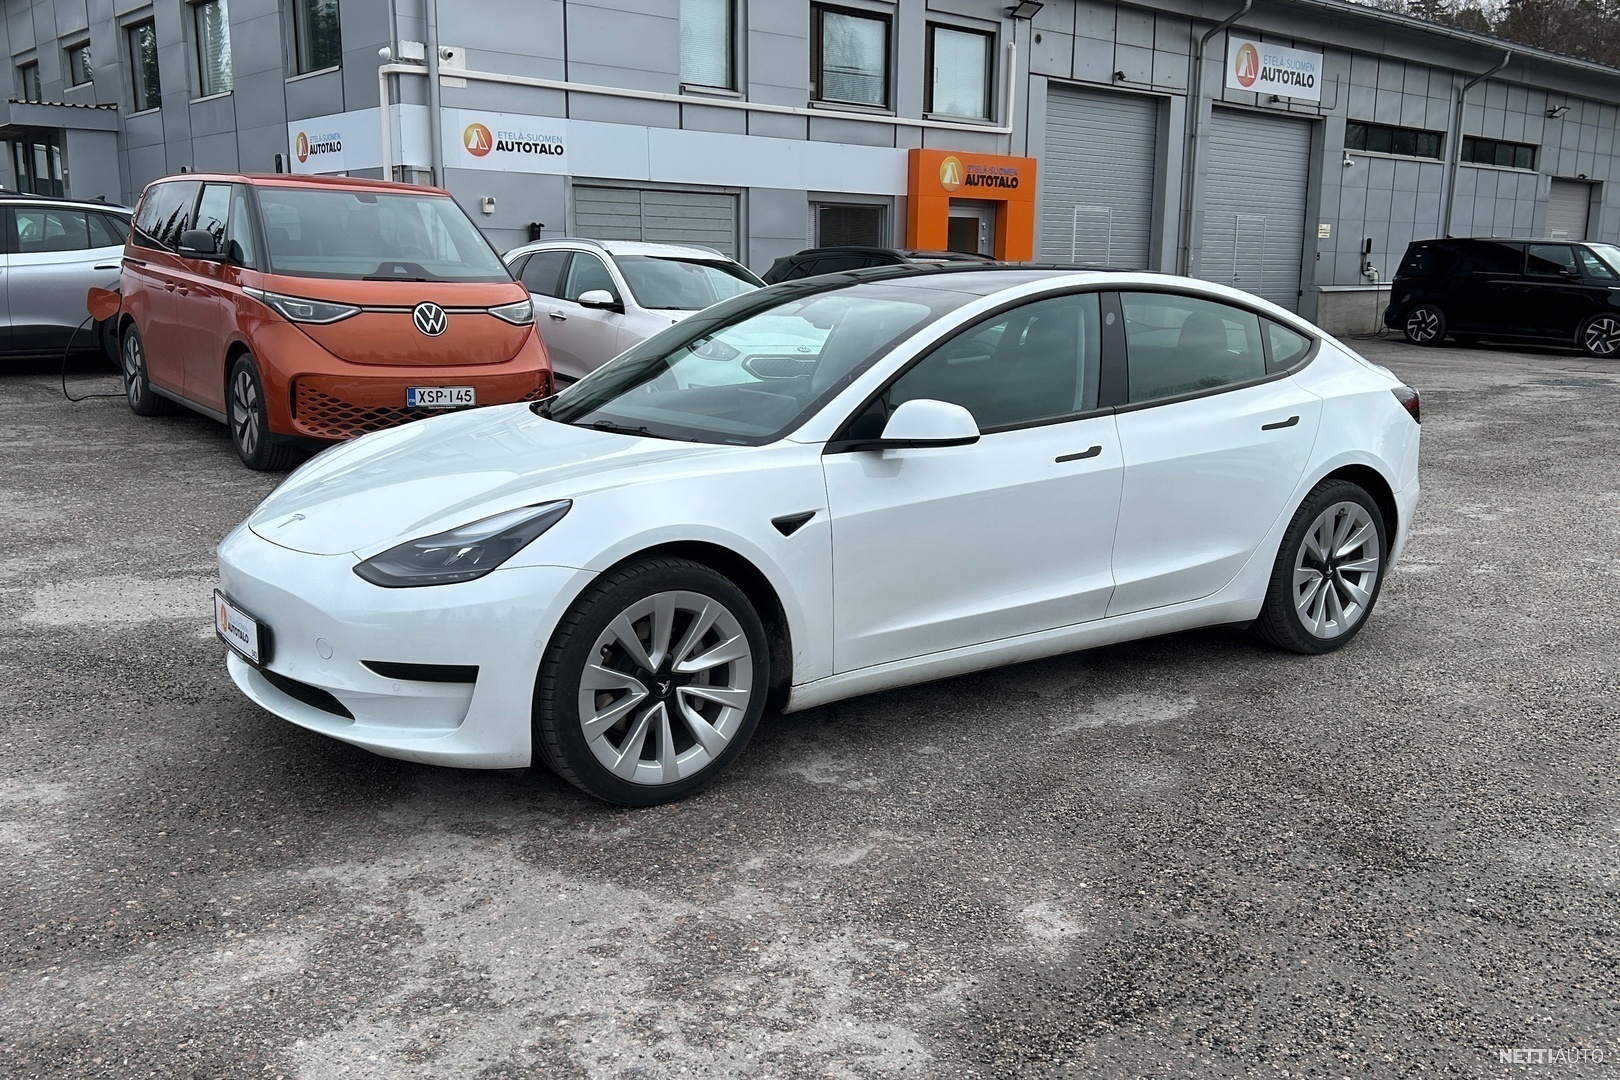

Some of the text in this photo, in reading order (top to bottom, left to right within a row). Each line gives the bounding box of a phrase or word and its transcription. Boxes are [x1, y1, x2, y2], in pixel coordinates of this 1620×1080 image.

[1263, 54, 1315, 73] ETELÄ-SUOMEN
[1260, 66, 1315, 88] AUTOTALO
[497, 130, 564, 144] ETELÄ-SUOMEN
[309, 141, 342, 156] AUTOTALO
[496, 140, 564, 156] AUTOTALO
[965, 174, 1019, 189] AUTOTALO
[418, 390, 472, 403] XSP-145
